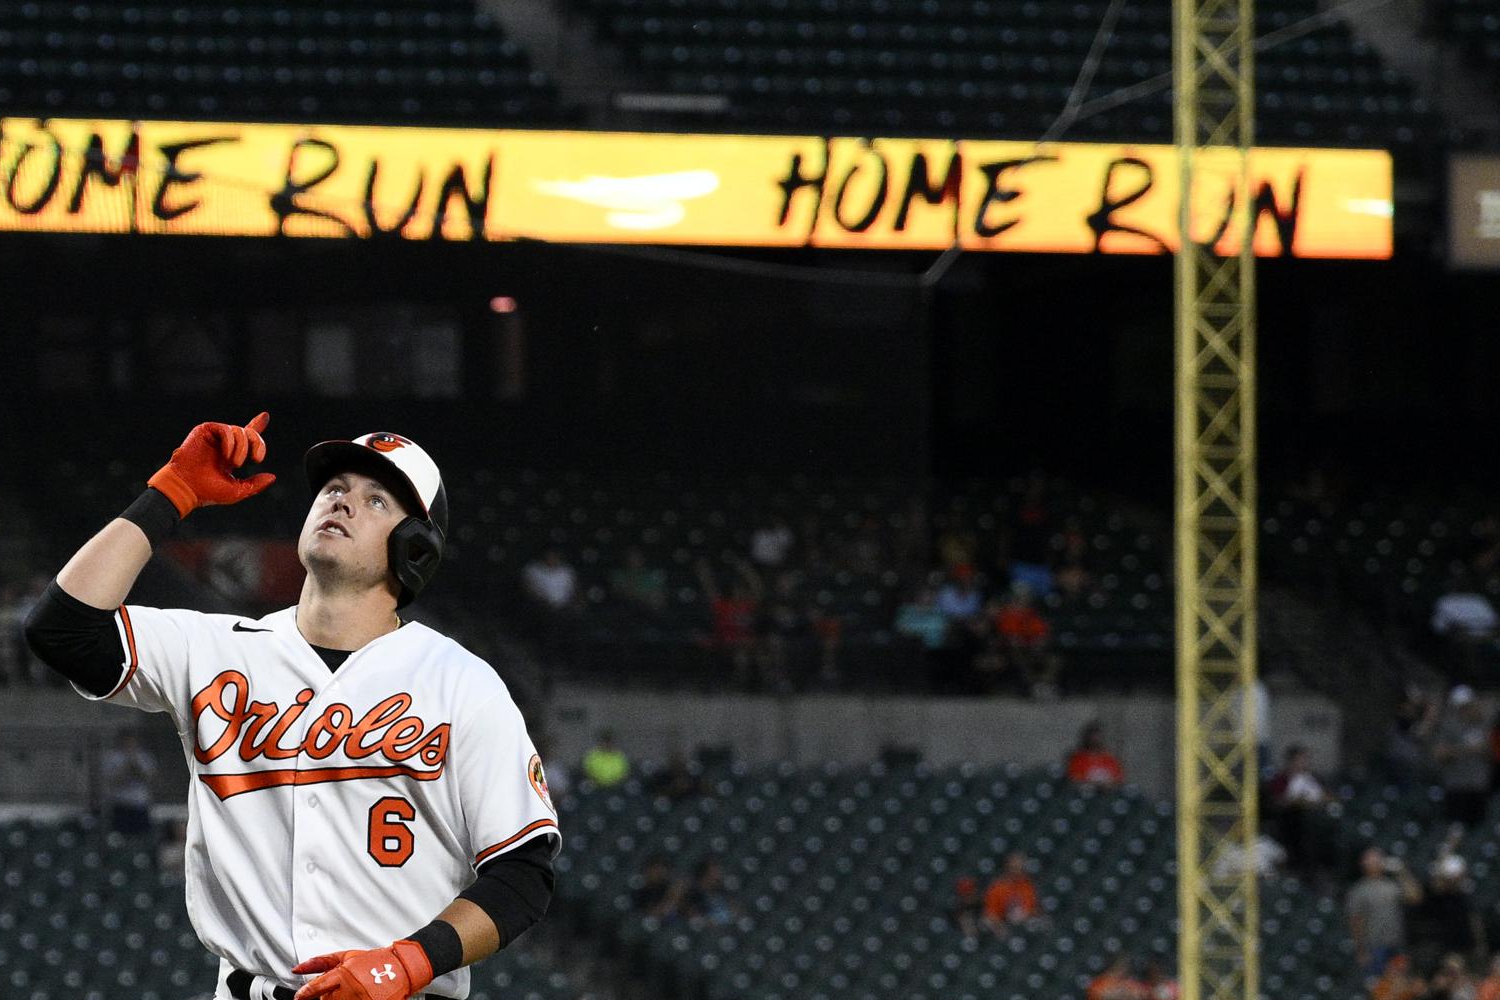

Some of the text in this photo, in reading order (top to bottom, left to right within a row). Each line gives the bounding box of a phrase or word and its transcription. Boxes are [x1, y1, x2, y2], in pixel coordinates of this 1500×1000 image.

[268, 138, 497, 239] RUN
[775, 138, 1304, 257] HOME RUN
[191, 669, 451, 768] Orioles
[367, 796, 417, 868] 6
